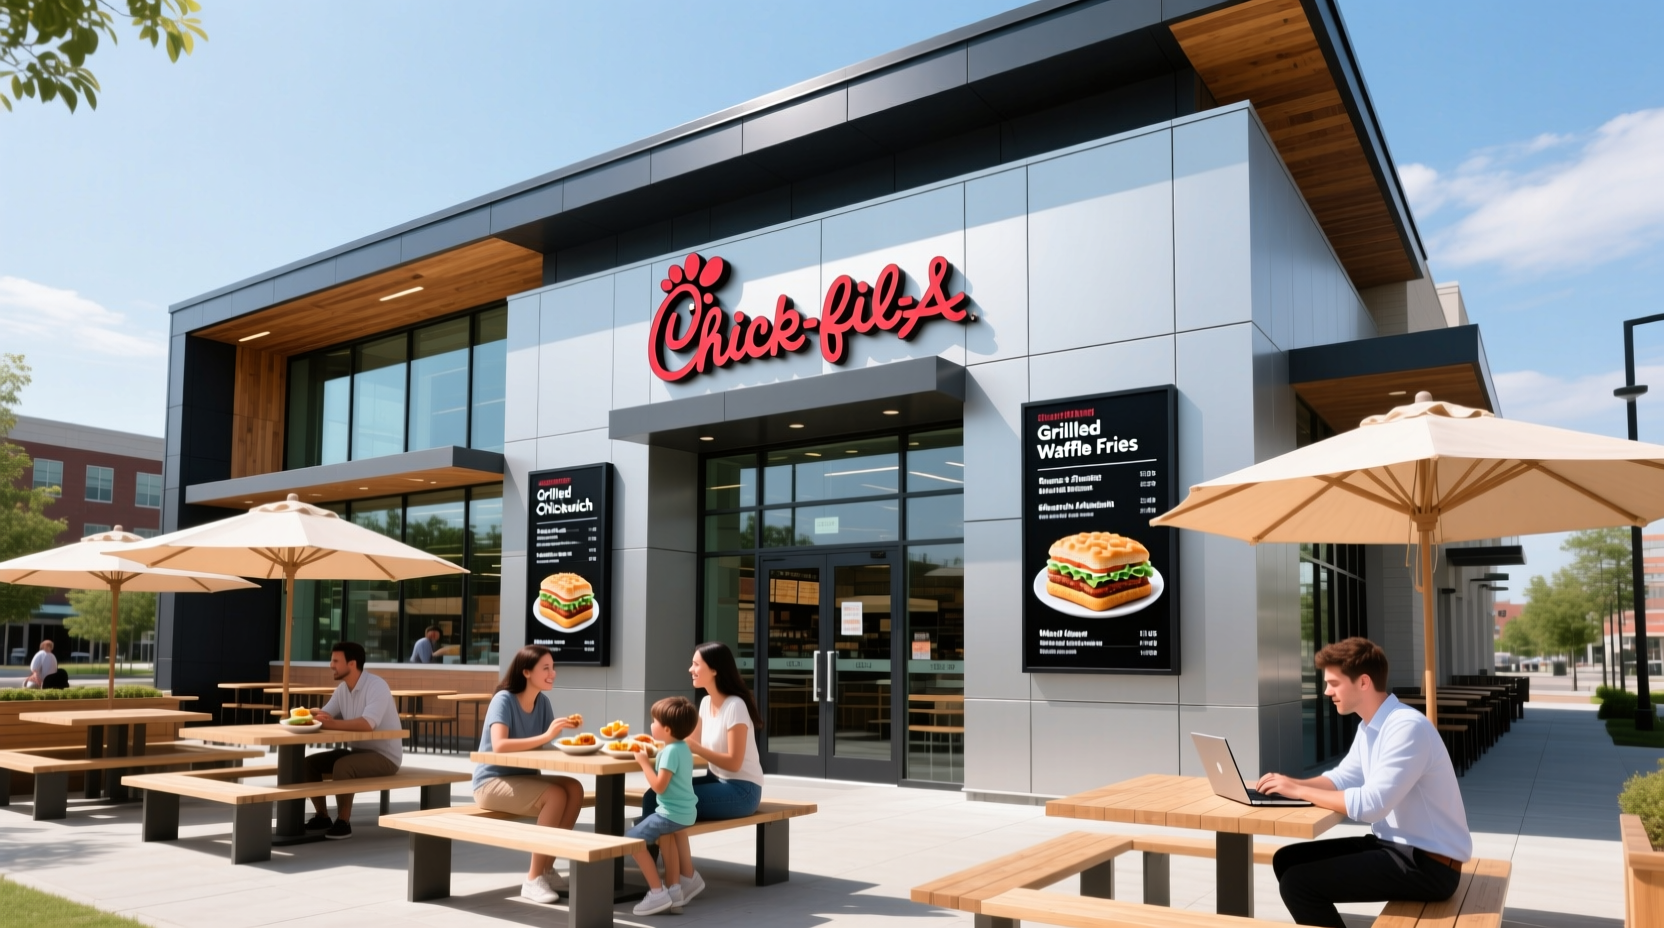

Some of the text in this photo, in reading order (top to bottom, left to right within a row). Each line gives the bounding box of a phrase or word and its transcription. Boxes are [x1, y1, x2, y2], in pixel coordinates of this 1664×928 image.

[648, 253, 968, 382] Chick-fil-A
[1037, 435, 1139, 460] Waffle Fries
